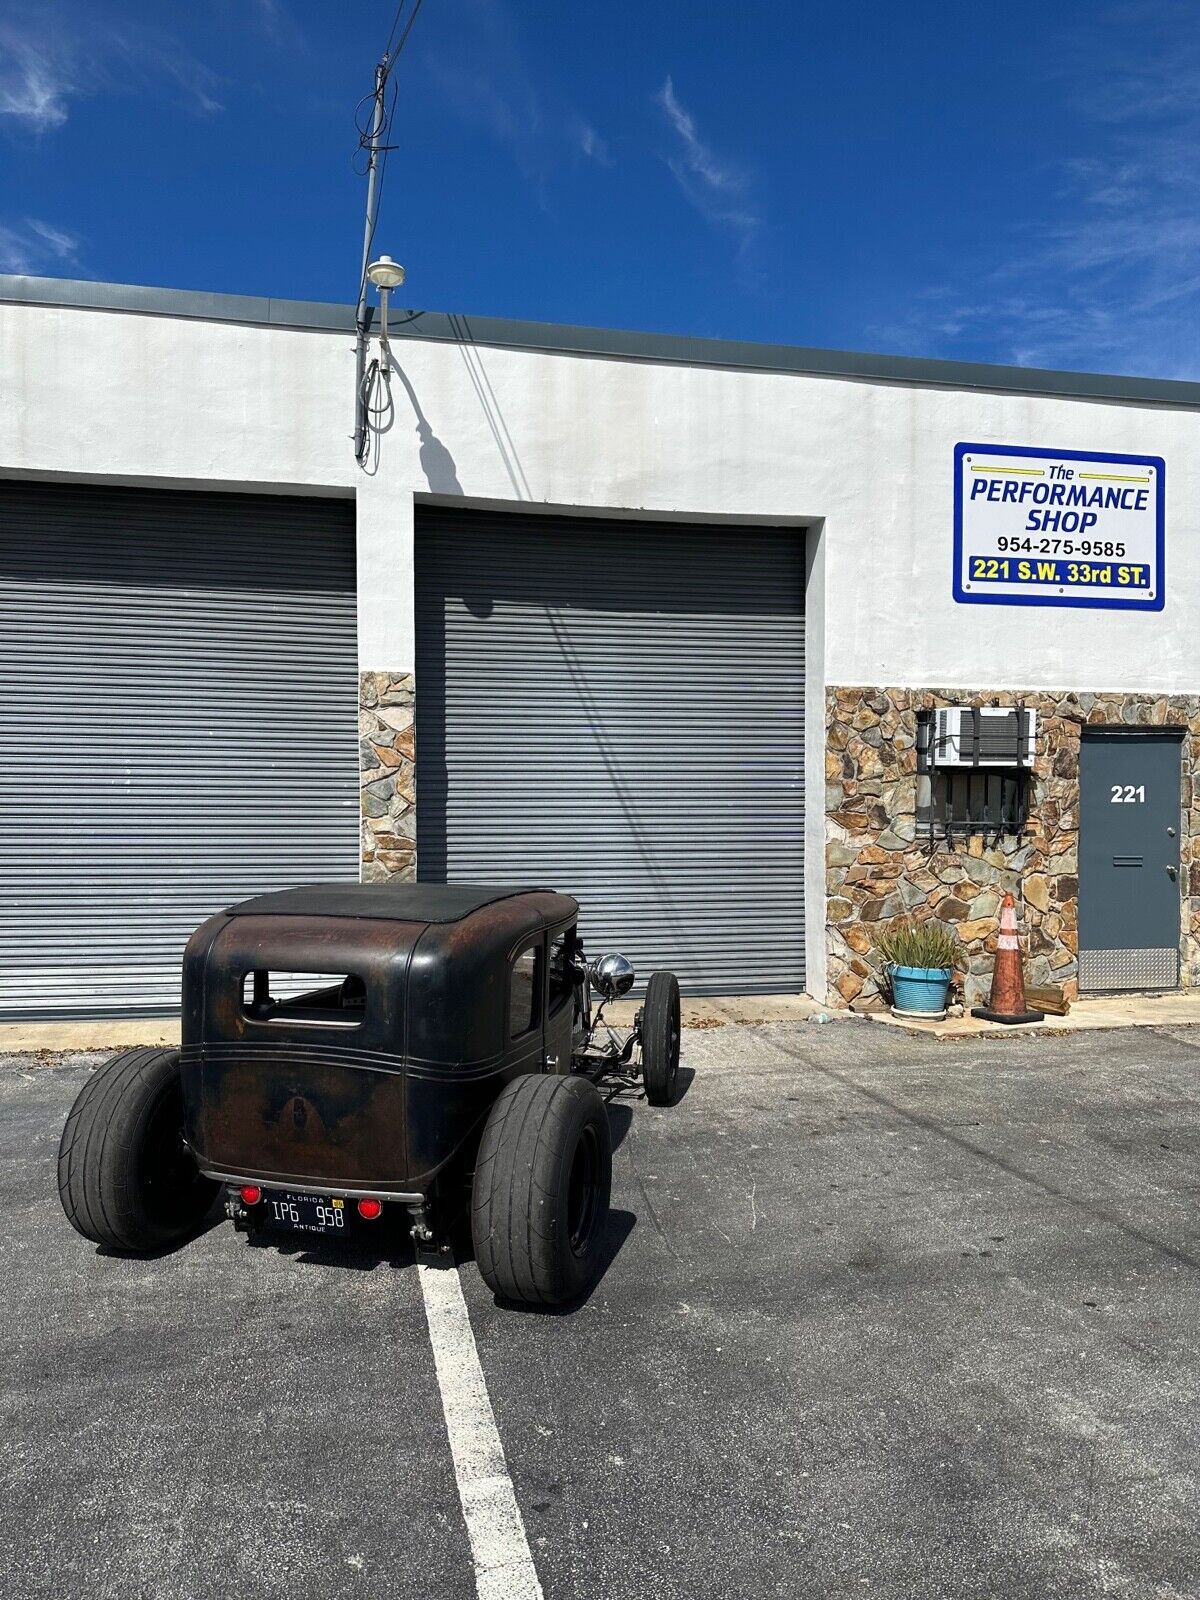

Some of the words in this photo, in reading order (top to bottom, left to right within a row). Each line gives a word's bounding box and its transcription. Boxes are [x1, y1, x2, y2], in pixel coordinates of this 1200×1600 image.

[1049, 464, 1074, 480] The
[970, 478, 1149, 511] PERFORMANCE
[1025, 509, 1097, 533] SHOP
[997, 536, 1126, 557] 954-275-9585
[973, 559, 1010, 579] 221
[1018, 561, 1060, 581] S.W.
[1067, 564, 1111, 583] 33rd
[1117, 567, 1146, 585] ST.
[1110, 785, 1145, 802] 221
[286, 1194, 323, 1203] FLORIDA
[316, 1206, 344, 1227] 958
[294, 1224, 326, 1232] ANTIQUE
